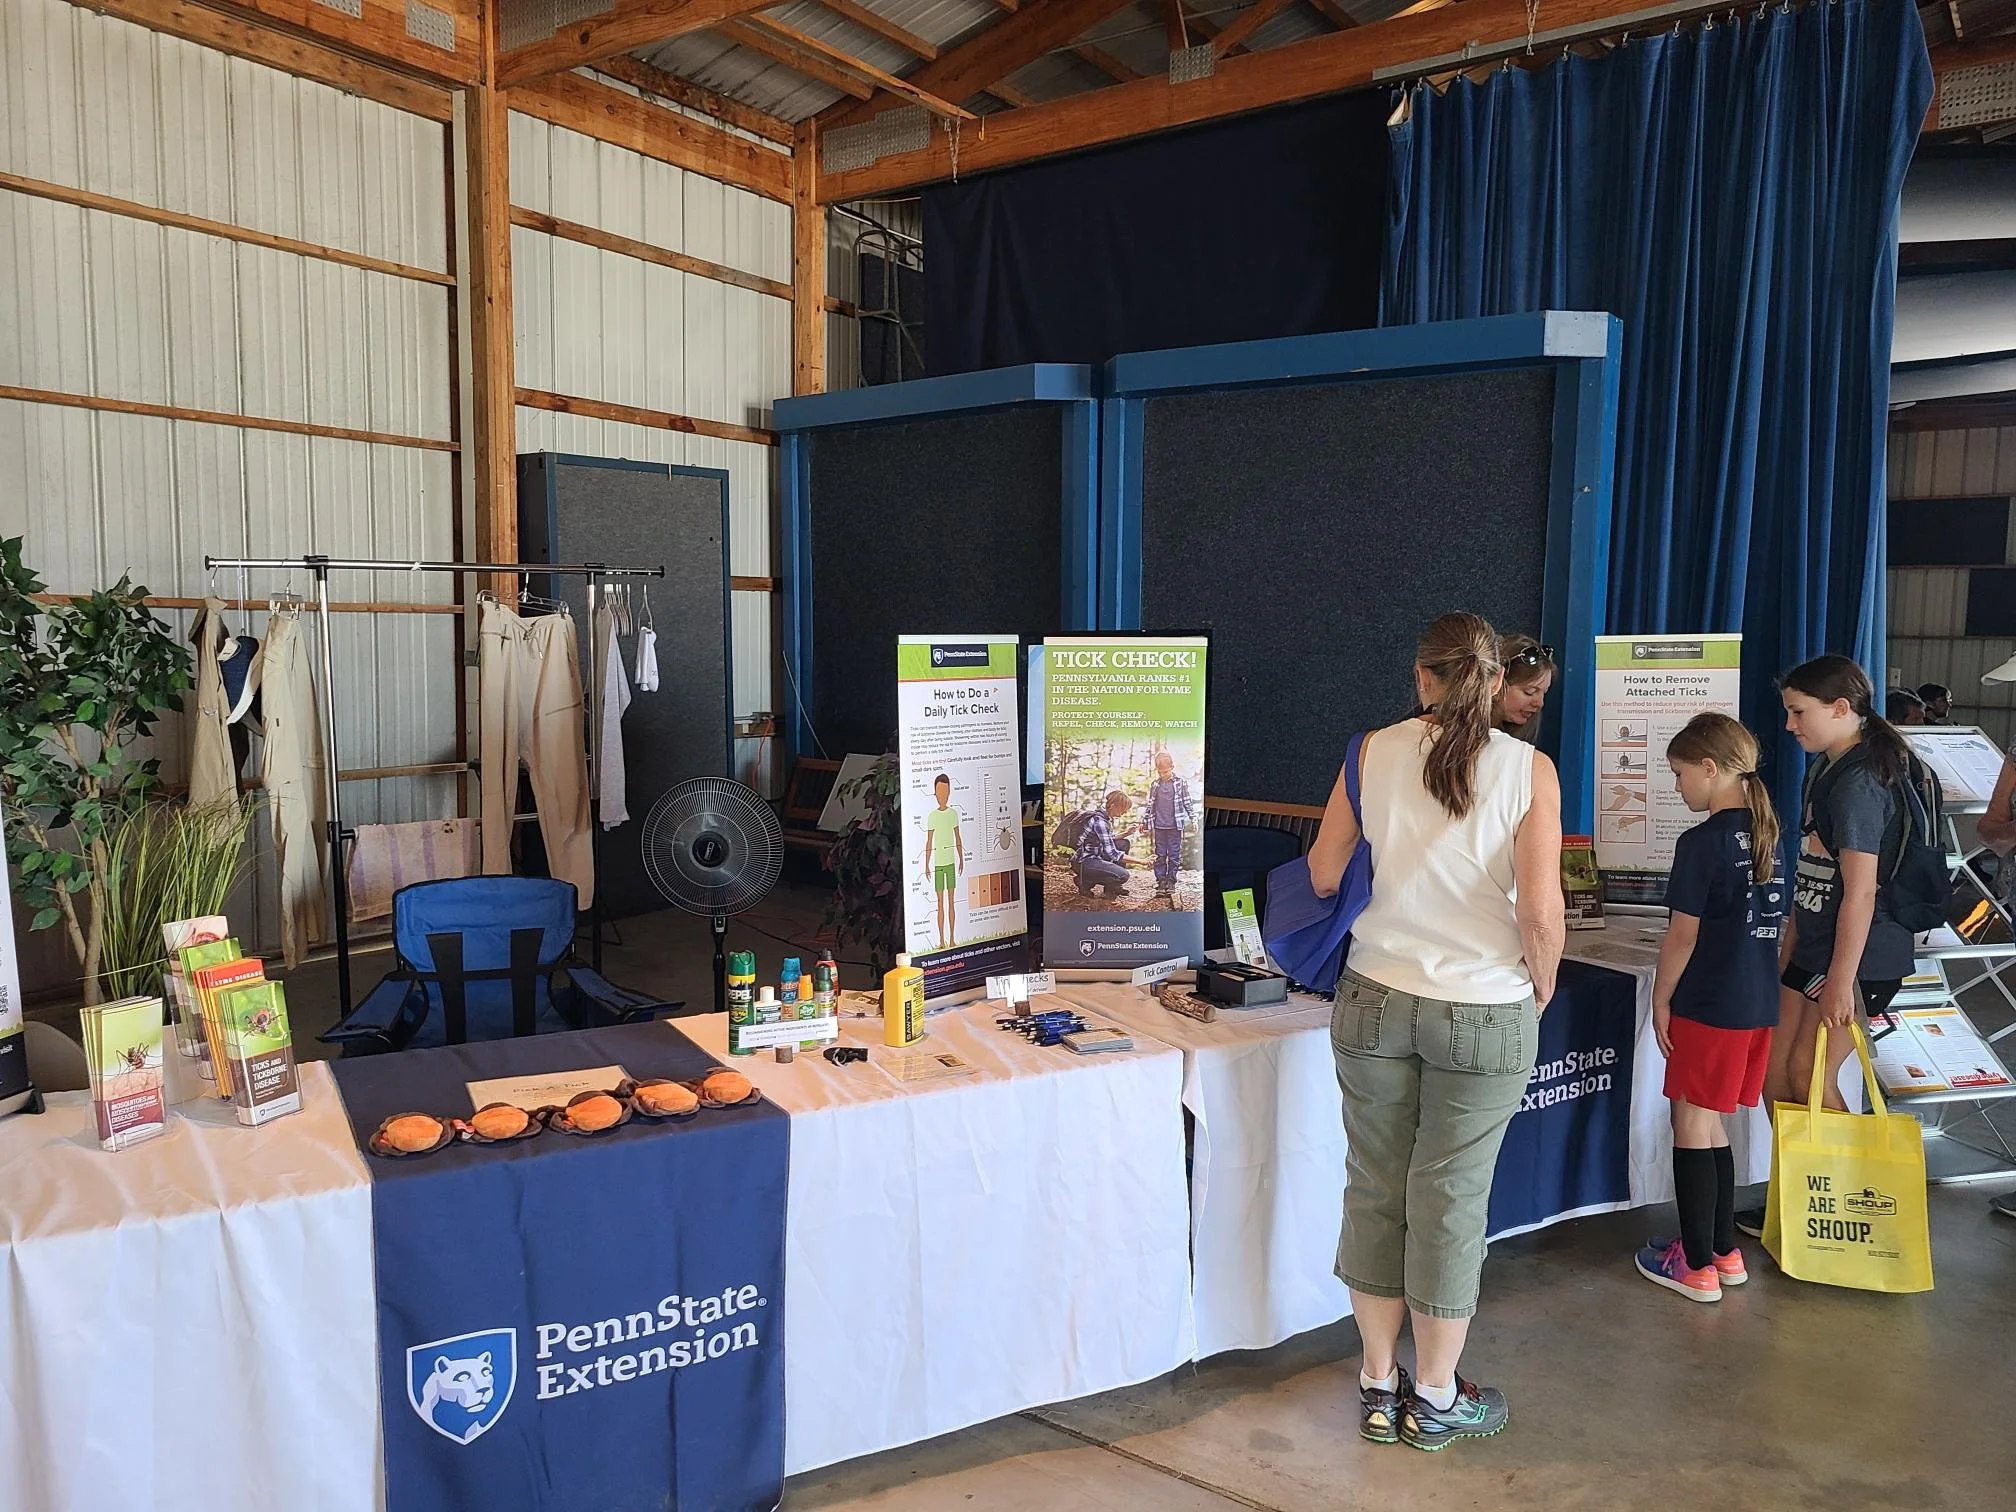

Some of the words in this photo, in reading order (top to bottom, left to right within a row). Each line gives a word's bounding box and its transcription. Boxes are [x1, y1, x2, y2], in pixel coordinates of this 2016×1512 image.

[1053, 652, 1107, 668] TICK
[1112, 651, 1196, 668] CHECK!
[1052, 674, 1136, 682] PENNSYLVANIA
[1139, 674, 1176, 682] RANKS
[1178, 674, 1190, 682] #1
[1624, 676, 1648, 684] How
[1666, 676, 1710, 684] Remove
[934, 689, 954, 700] How
[956, 688, 966, 698] to
[968, 688, 982, 698] Do
[1052, 686, 1064, 694] IN
[1066, 686, 1088, 694] THE
[1092, 686, 1136, 694] NATION
[1137, 686, 1160, 694] FOR
[1162, 686, 1192, 694] LYME
[1626, 688, 1676, 696] Attached
[1678, 688, 1708, 696] Ticks
[1052, 697, 1102, 706] DISEASE.
[924, 705, 948, 718] Daily
[950, 704, 968, 715] Tick
[971, 703, 999, 714] Check
[1087, 924, 1161, 933] extension.psu.edu
[924, 962, 965, 976] xtension.psu.edu
[1144, 968, 1156, 978] Tick
[1156, 962, 1178, 976] Control
[215, 978, 233, 986] LYME
[235, 971, 262, 982] DISEASE
[729, 989, 751, 1000] REPEL
[251, 1060, 270, 1072] TICKS
[271, 1058, 281, 1067] AND
[252, 1064, 288, 1080] TICKBORNE
[254, 1077, 280, 1090] DISEASE
[112, 1096, 147, 1110] MOSQUITOES
[112, 1112, 139, 1124] DISEASES
[1807, 1175, 1831, 1192] WE
[1808, 1196, 1836, 1214] ARE
[1848, 1199, 1893, 1209] SHOUP
[1807, 1218, 1873, 1244] SHOUP.
[536, 1322, 758, 1400] Extension
